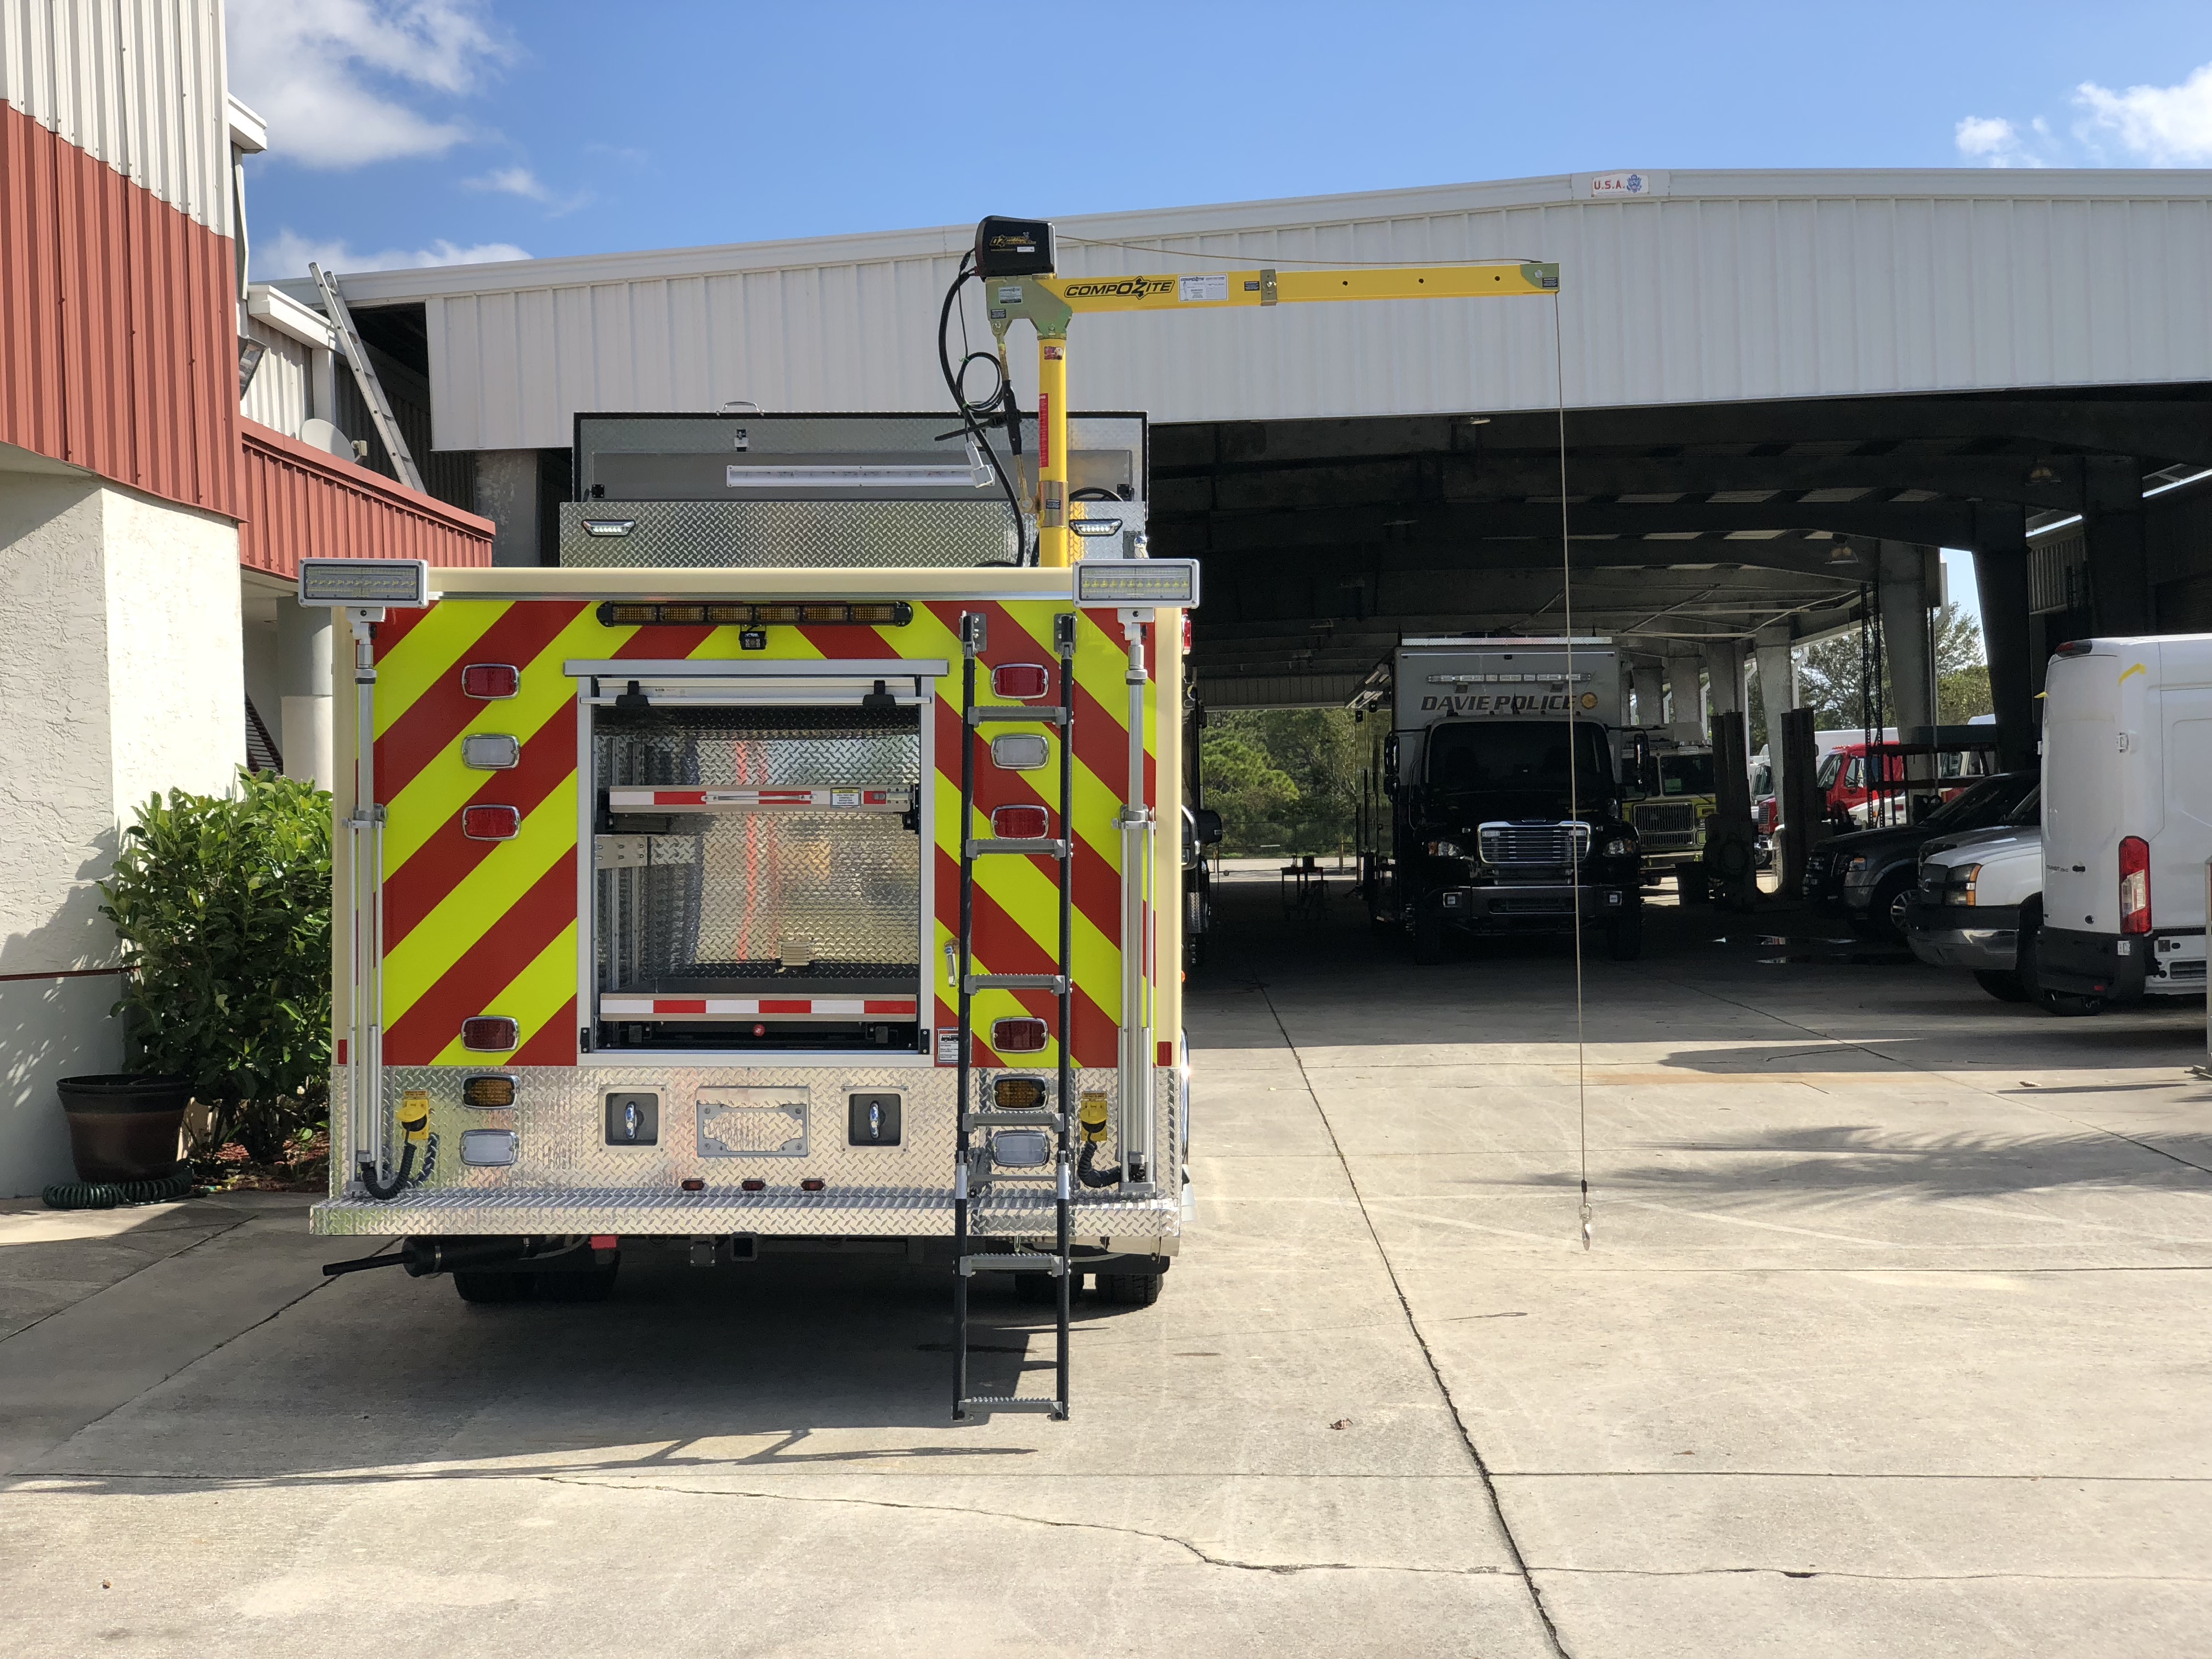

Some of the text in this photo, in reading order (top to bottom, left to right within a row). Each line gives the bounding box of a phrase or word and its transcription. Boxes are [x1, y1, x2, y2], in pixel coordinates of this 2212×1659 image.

[1594, 179, 1626, 190] U.S.A.
[1066, 278, 1172, 298] COMPOZITE
[1420, 695, 1577, 710] DAVIE POLICE
